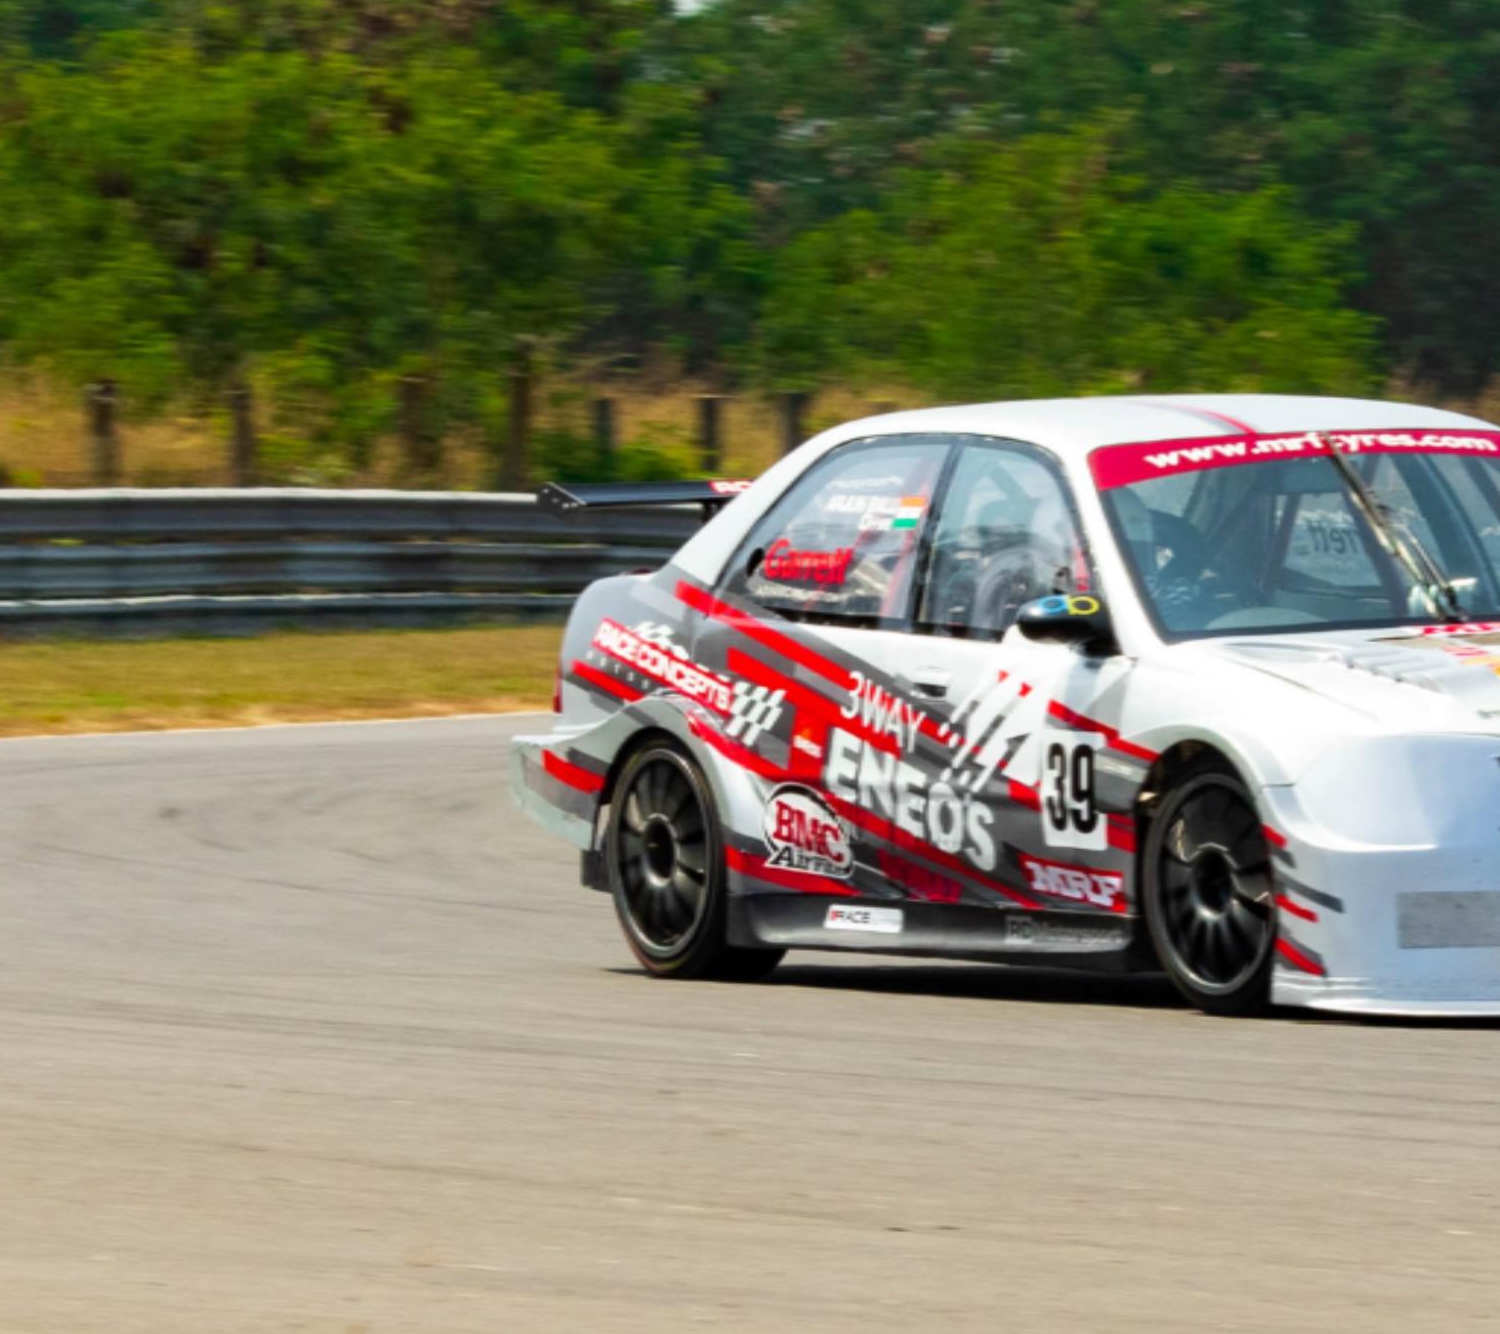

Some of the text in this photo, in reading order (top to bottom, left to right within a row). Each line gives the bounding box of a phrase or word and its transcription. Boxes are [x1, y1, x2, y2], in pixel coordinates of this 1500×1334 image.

[764, 538, 855, 585] Garrett
[595, 620, 731, 713] RACE CONCEPTS
[840, 670, 926, 754] 3WAY
[824, 725, 996, 872] ENEOS
[1046, 741, 1100, 834] 39
[773, 799, 845, 863] BMC
[1024, 860, 1123, 908] MRF
